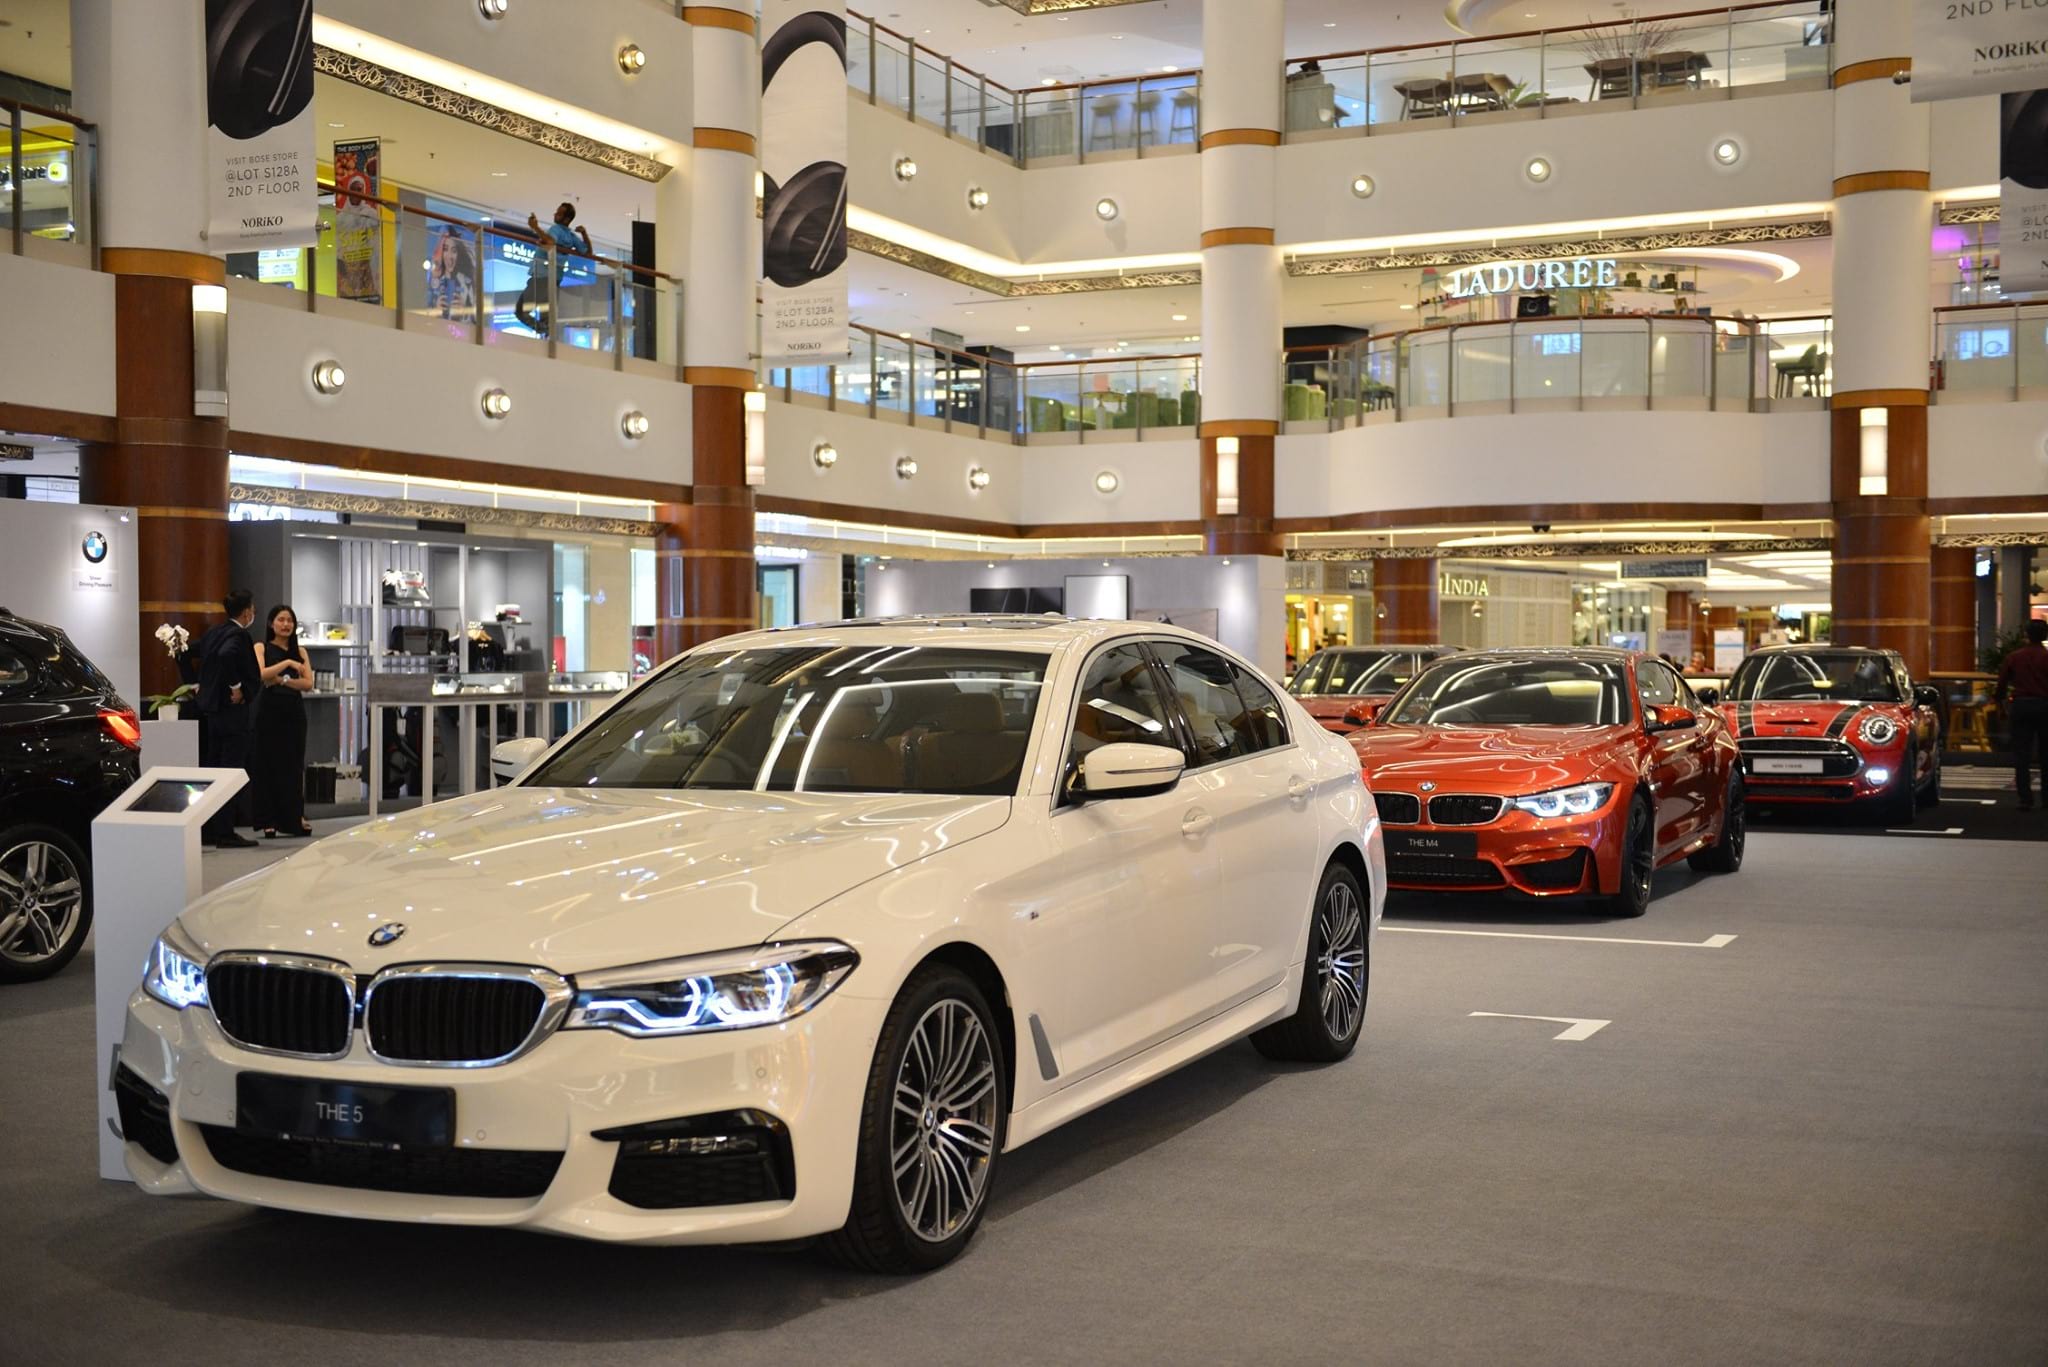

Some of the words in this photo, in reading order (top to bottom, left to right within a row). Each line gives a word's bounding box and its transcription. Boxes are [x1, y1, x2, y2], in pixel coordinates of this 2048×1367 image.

[1946, 0, 1993, 20] 2ND
[226, 156, 246, 166] VISIT
[249, 154, 270, 164] BOSE
[272, 152, 298, 161] STORE
[225, 168, 259, 182] @LOT
[264, 165, 299, 178] S128A
[228, 185, 252, 197] 2ND
[258, 181, 300, 194] FLOOR
[1452, 257, 1616, 298] LADURÉE
[776, 320, 796, 329] 2ND
[800, 318, 834, 327] FLOOR
[1408, 838, 1424, 847] THE
[1426, 839, 1439, 847] M4
[316, 1102, 349, 1122] THE
[352, 1105, 364, 1123] 5
